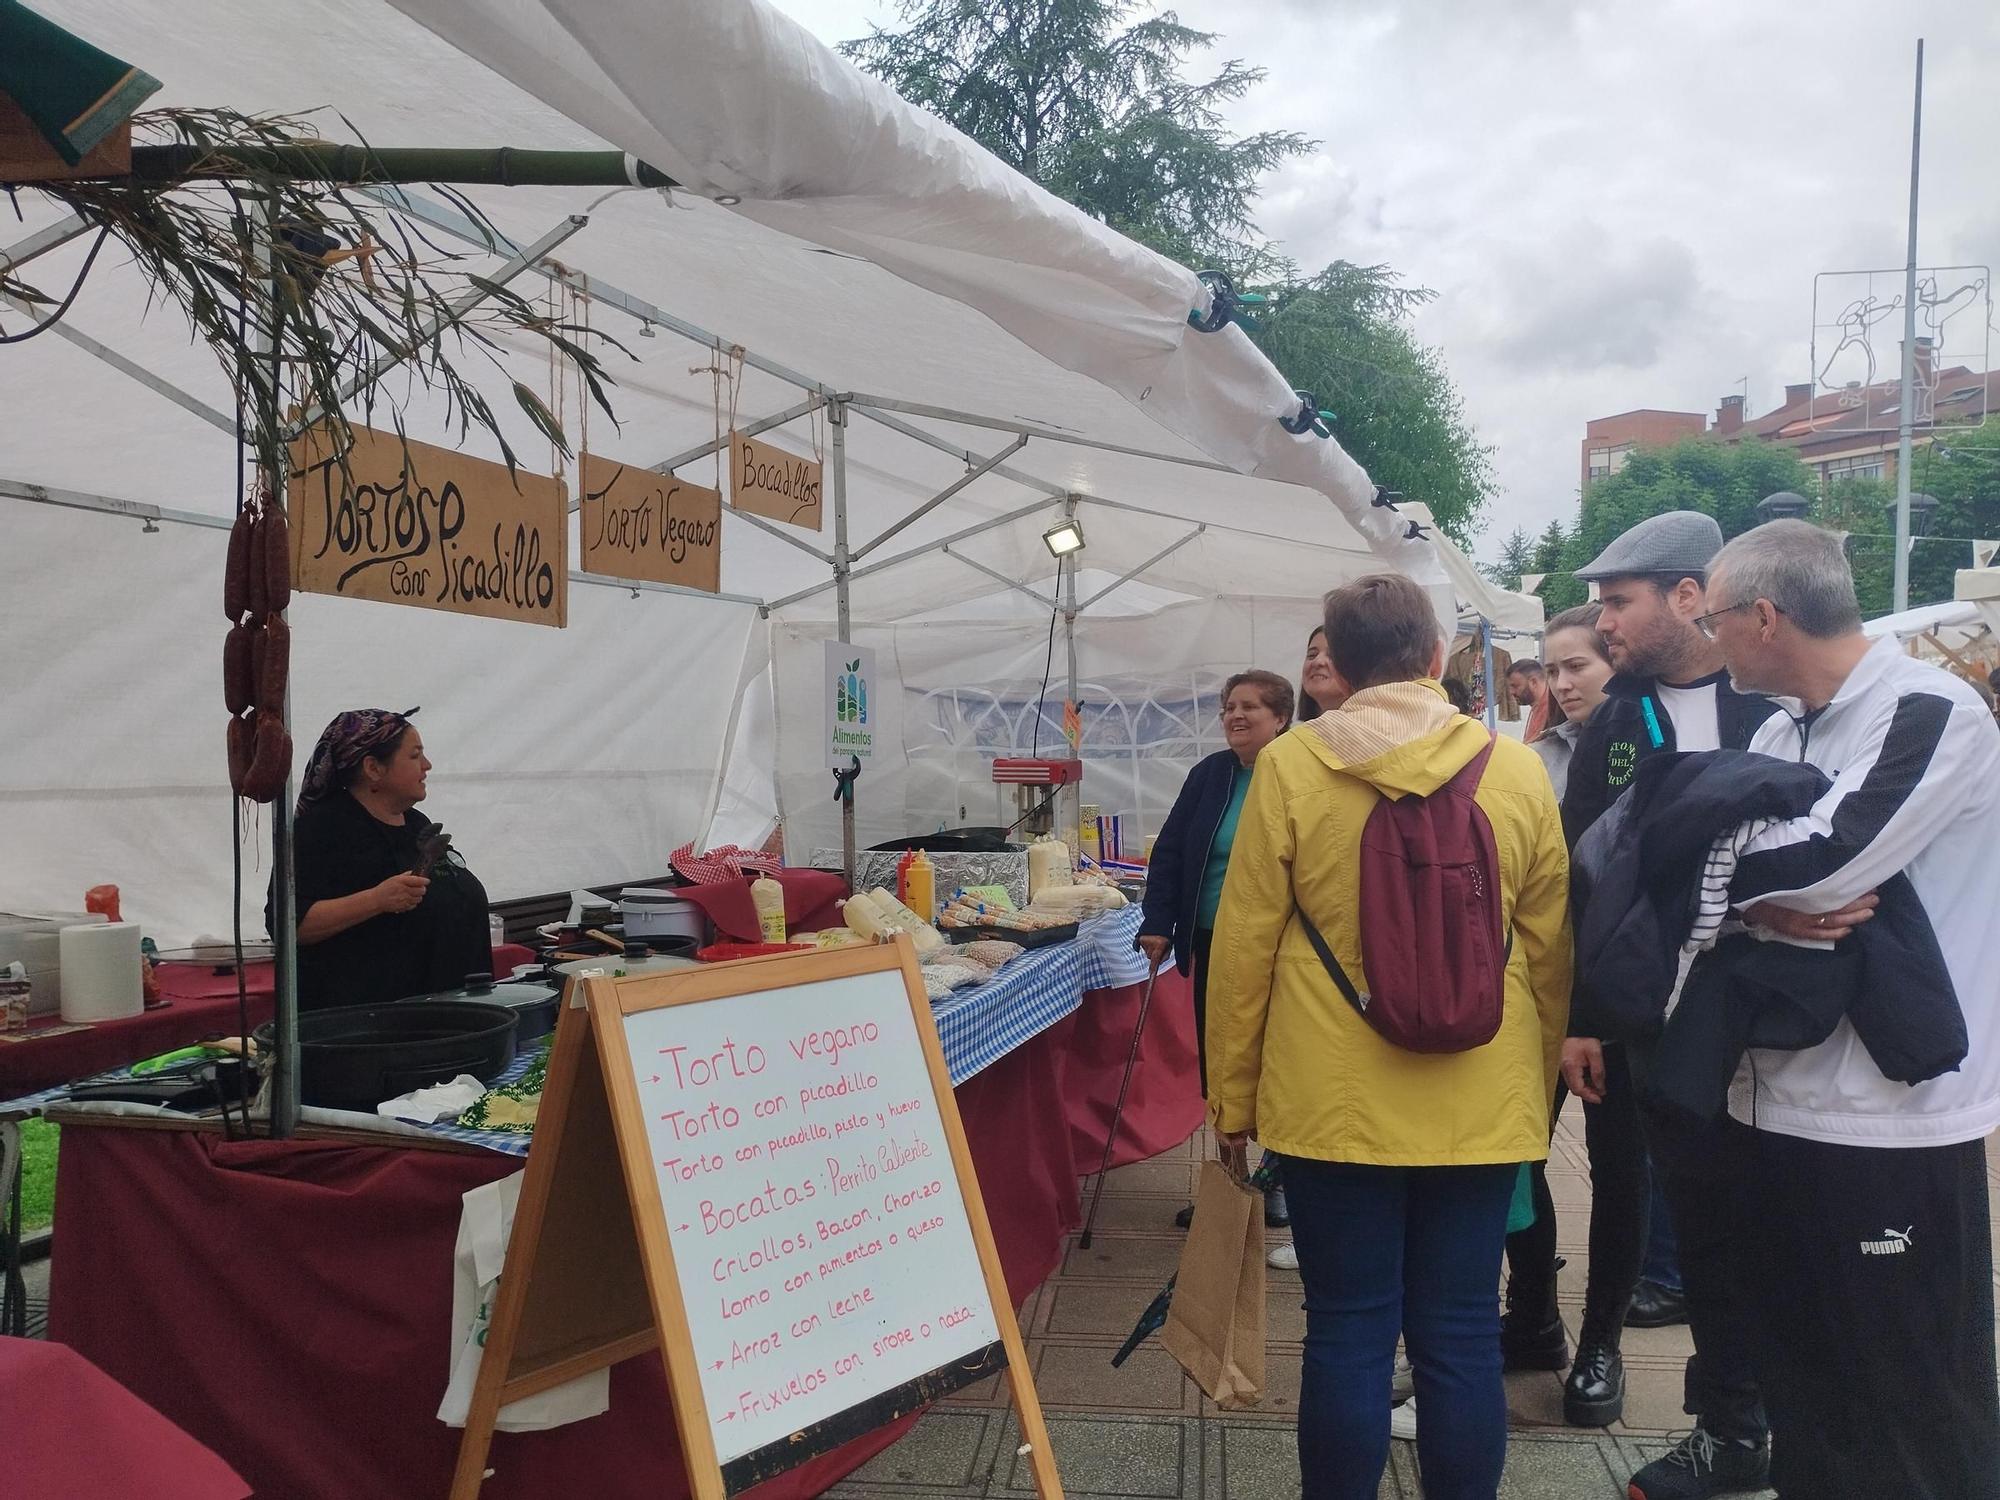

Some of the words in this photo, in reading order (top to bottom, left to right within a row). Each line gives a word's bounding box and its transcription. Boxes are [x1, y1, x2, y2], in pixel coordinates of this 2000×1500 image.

[832, 725, 872, 746] Alimentos
[1611, 758, 1630, 767] DEL
[659, 1036, 766, 1090] Torto
[789, 1022, 878, 1066] vegano
[661, 1102, 740, 1140] Torto
[754, 1095, 788, 1118] con
[800, 1072, 878, 1113] picadillo
[663, 1154, 724, 1184] Torto
[735, 1144, 762, 1162] con
[768, 1122, 832, 1160] picadillo,
[835, 1116, 870, 1138] pisto
[876, 1112, 885, 1129] y
[888, 1098, 921, 1117] huevo
[827, 1155, 877, 1197] Perrito
[878, 1130, 933, 1174] Caliente
[884, 1180, 942, 1214] Chorizo
[721, 1289, 770, 1320] Lomo
[784, 1271, 813, 1293] con
[819, 1239, 883, 1281] pimientos
[889, 1233, 898, 1246] o
[907, 1215, 944, 1243] queso
[731, 1332, 782, 1370] Arroz
[791, 1314, 822, 1339] con
[828, 1286, 874, 1320] leche
[739, 1368, 827, 1423] Frixuelos
[834, 1352, 864, 1377] con
[873, 1327, 914, 1358] sirope
[920, 1323, 931, 1338] o
